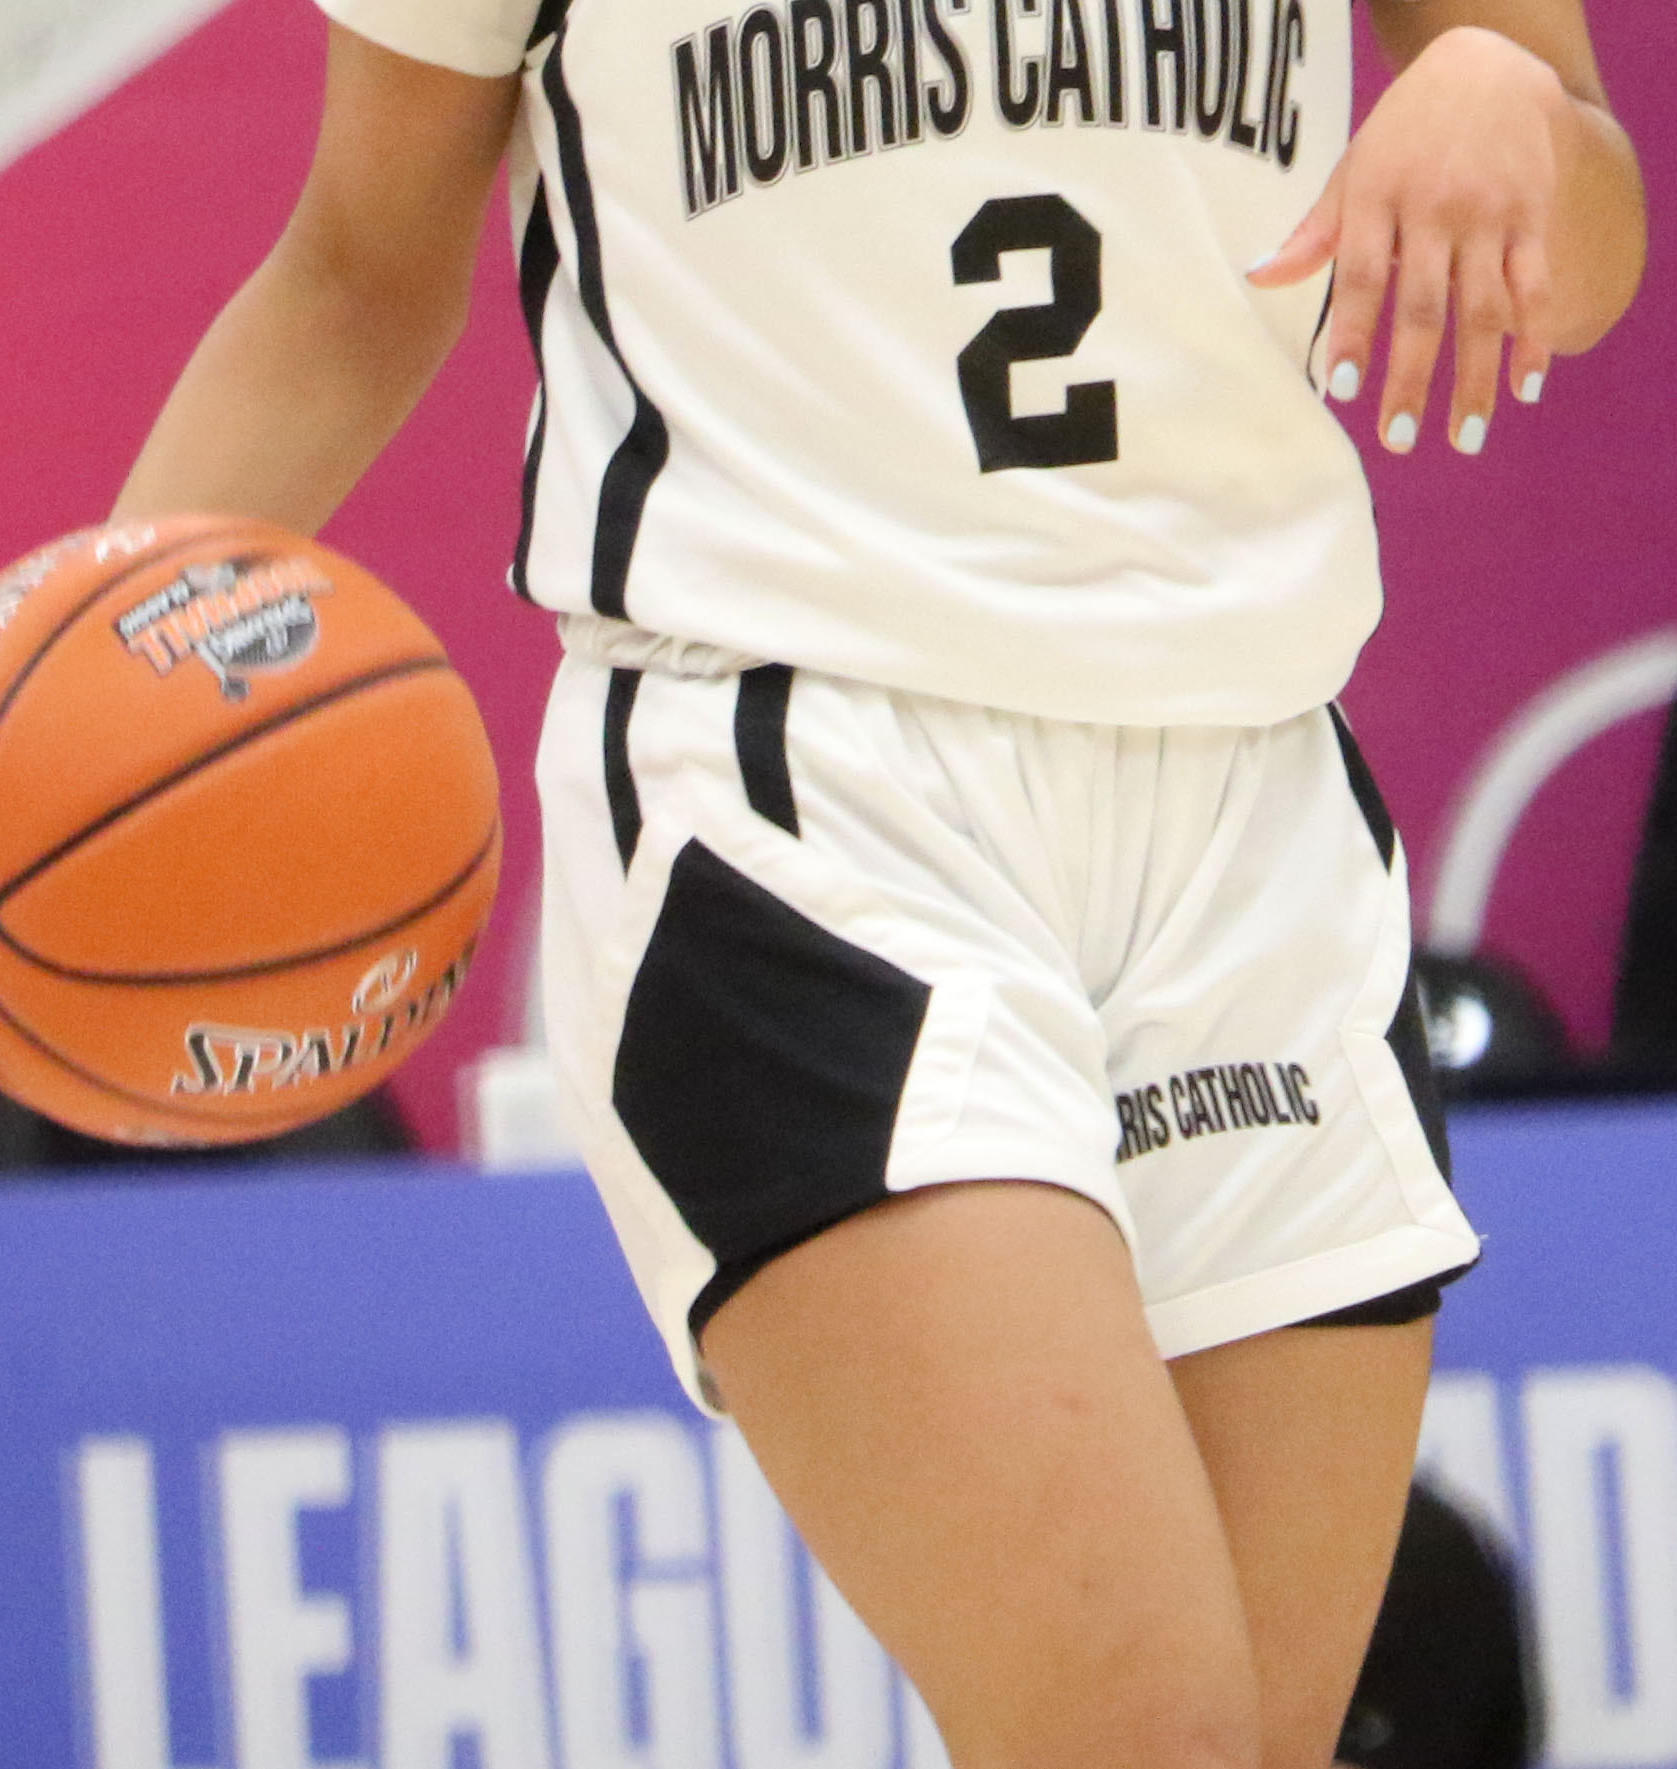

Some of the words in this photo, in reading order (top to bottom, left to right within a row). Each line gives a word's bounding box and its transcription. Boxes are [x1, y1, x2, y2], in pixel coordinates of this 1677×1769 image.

[951, 193, 1119, 474] 2
[1115, 1083, 1172, 1165] RIS
[1169, 1061, 1320, 1141] CATHOLIC
[69, 1410, 964, 1769] LEAGU
